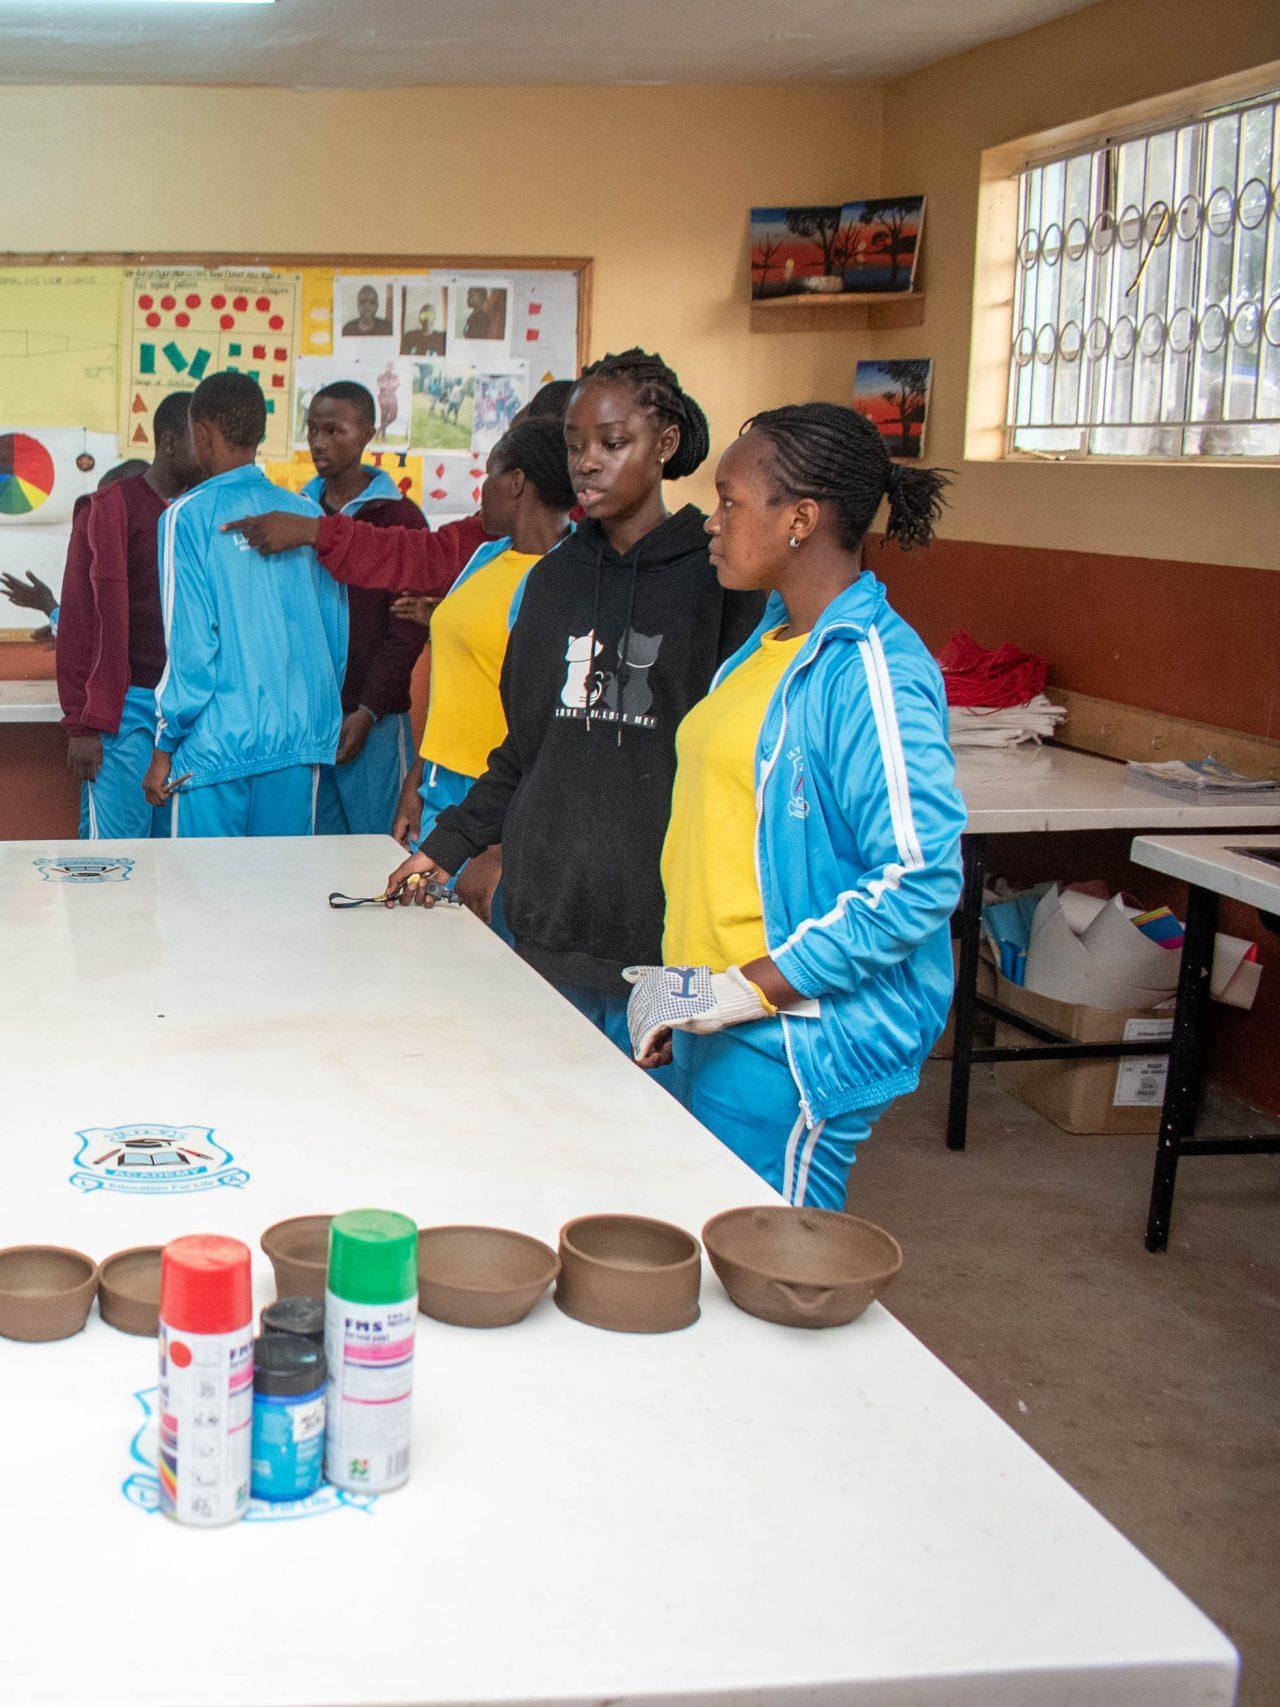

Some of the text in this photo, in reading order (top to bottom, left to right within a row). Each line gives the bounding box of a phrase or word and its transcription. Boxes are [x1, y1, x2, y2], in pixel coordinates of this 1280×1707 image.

[555, 708, 578, 718] LOVE
[633, 715, 656, 727] ME!
[112, 1167, 199, 1180] ACADEMY
